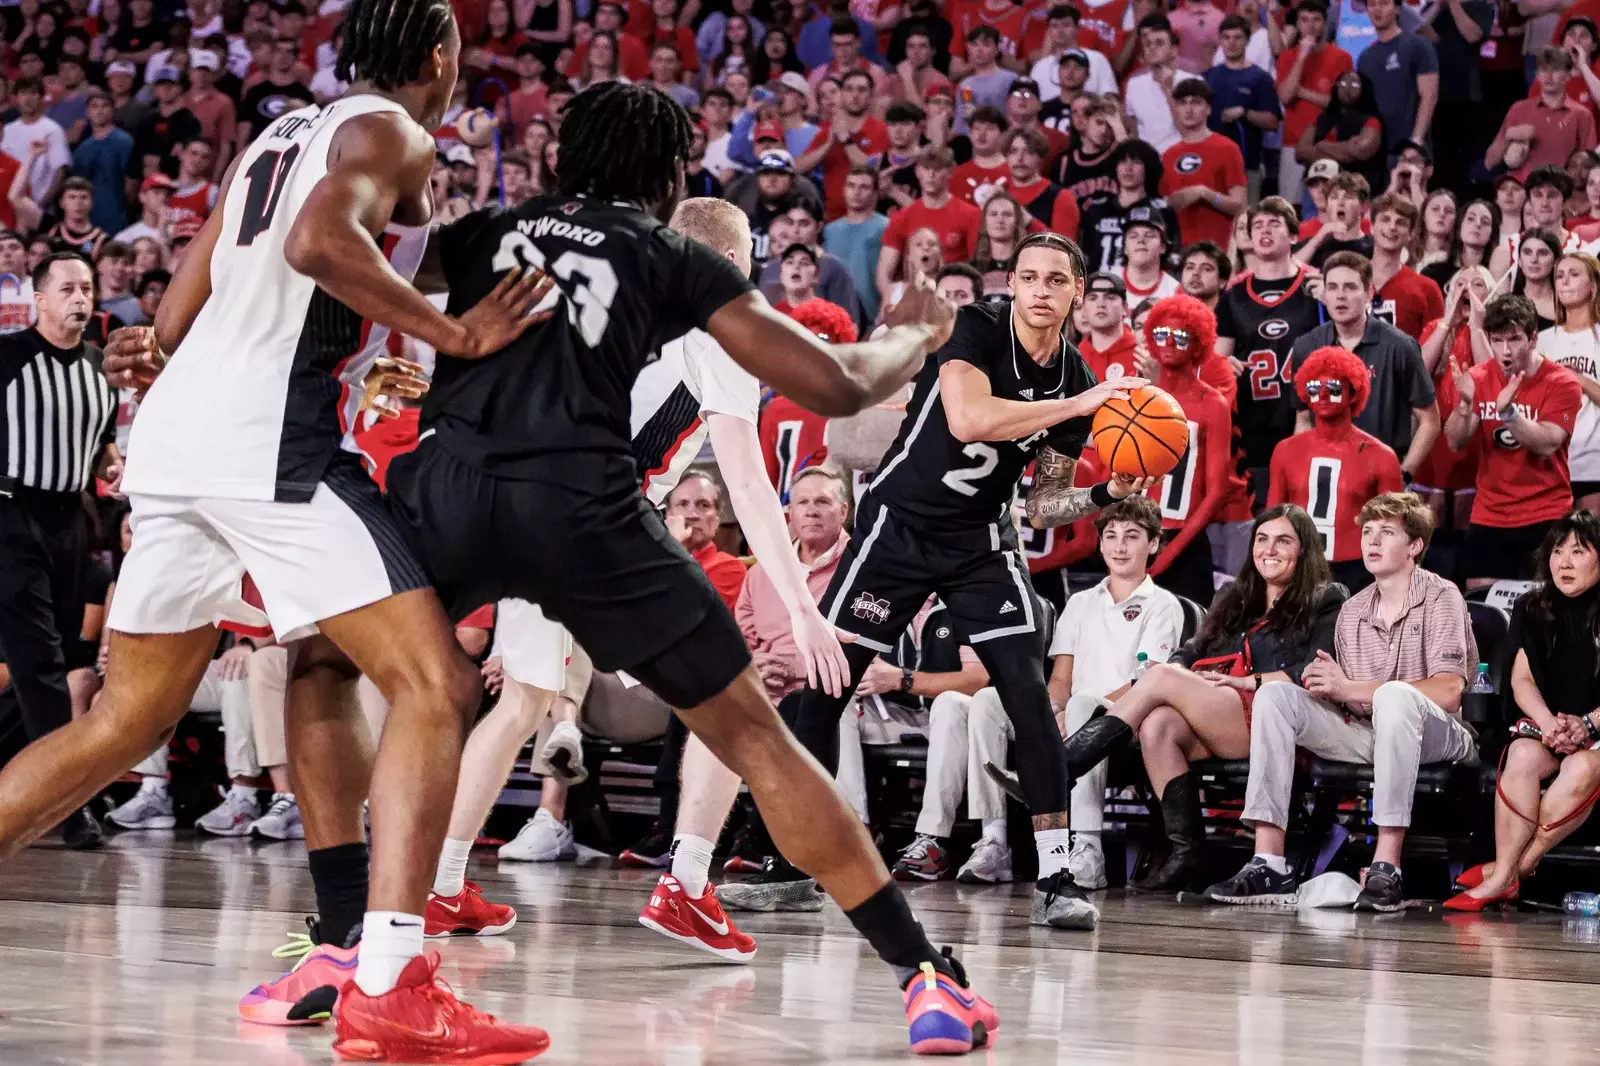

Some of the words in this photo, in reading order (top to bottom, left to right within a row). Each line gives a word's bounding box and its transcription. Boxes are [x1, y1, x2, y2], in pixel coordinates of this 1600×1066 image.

[517, 216, 606, 247] NWOKO
[941, 442, 999, 497] 2
[857, 601, 885, 618] STATE
